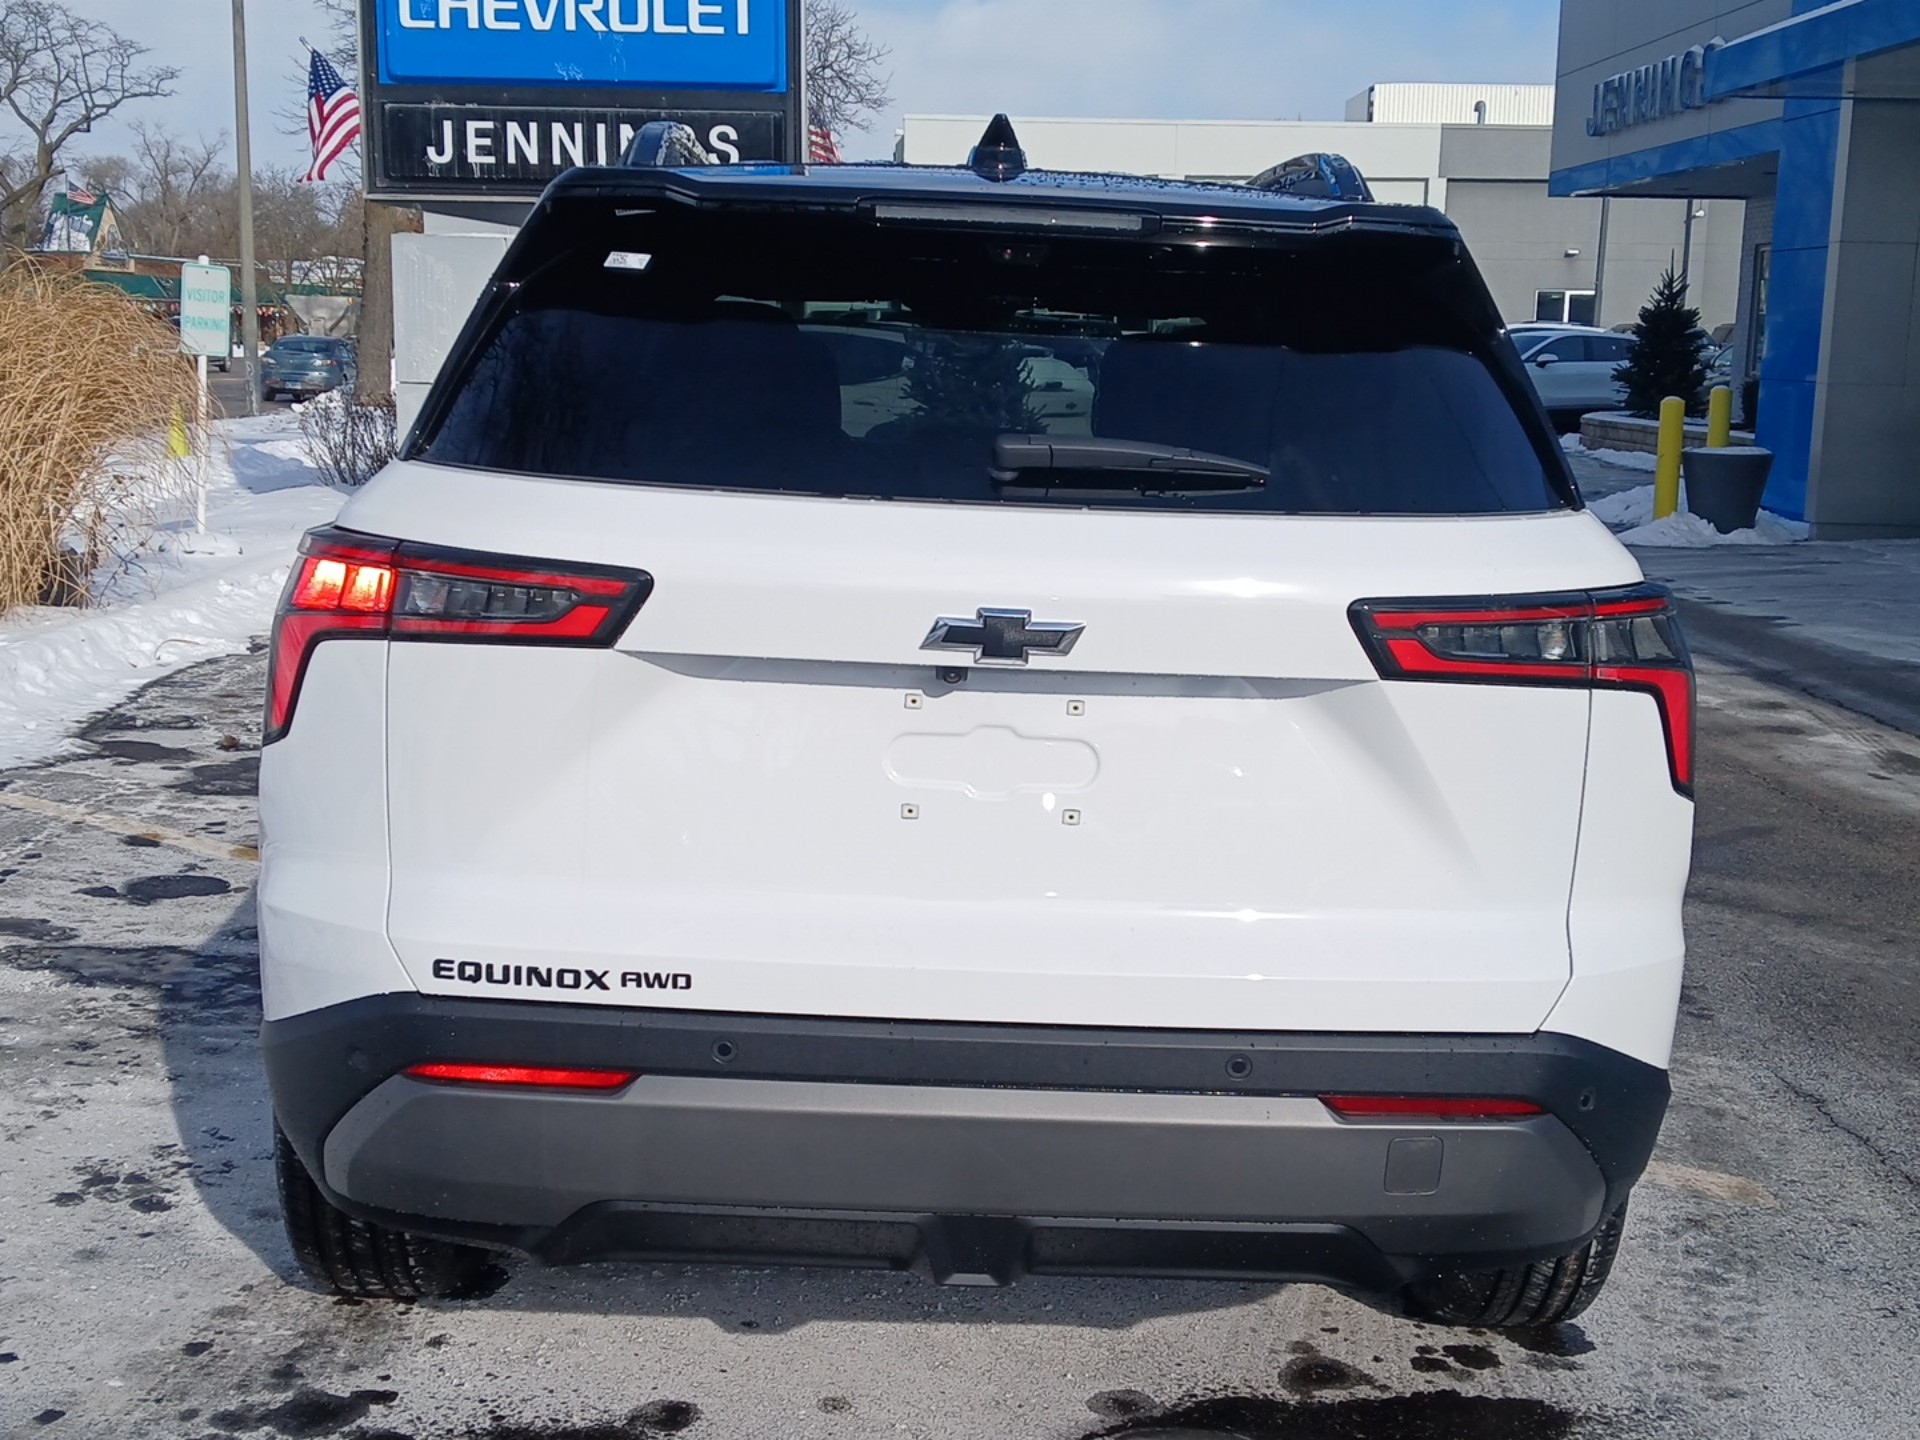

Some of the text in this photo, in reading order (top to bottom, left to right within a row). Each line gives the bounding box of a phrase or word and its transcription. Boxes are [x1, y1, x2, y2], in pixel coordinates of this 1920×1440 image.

[426, 120, 740, 167] JENNIS
[186, 288, 225, 303] VISITOR
[184, 315, 227, 331] PARKING
[432, 958, 692, 991] EQUINOX AWD
